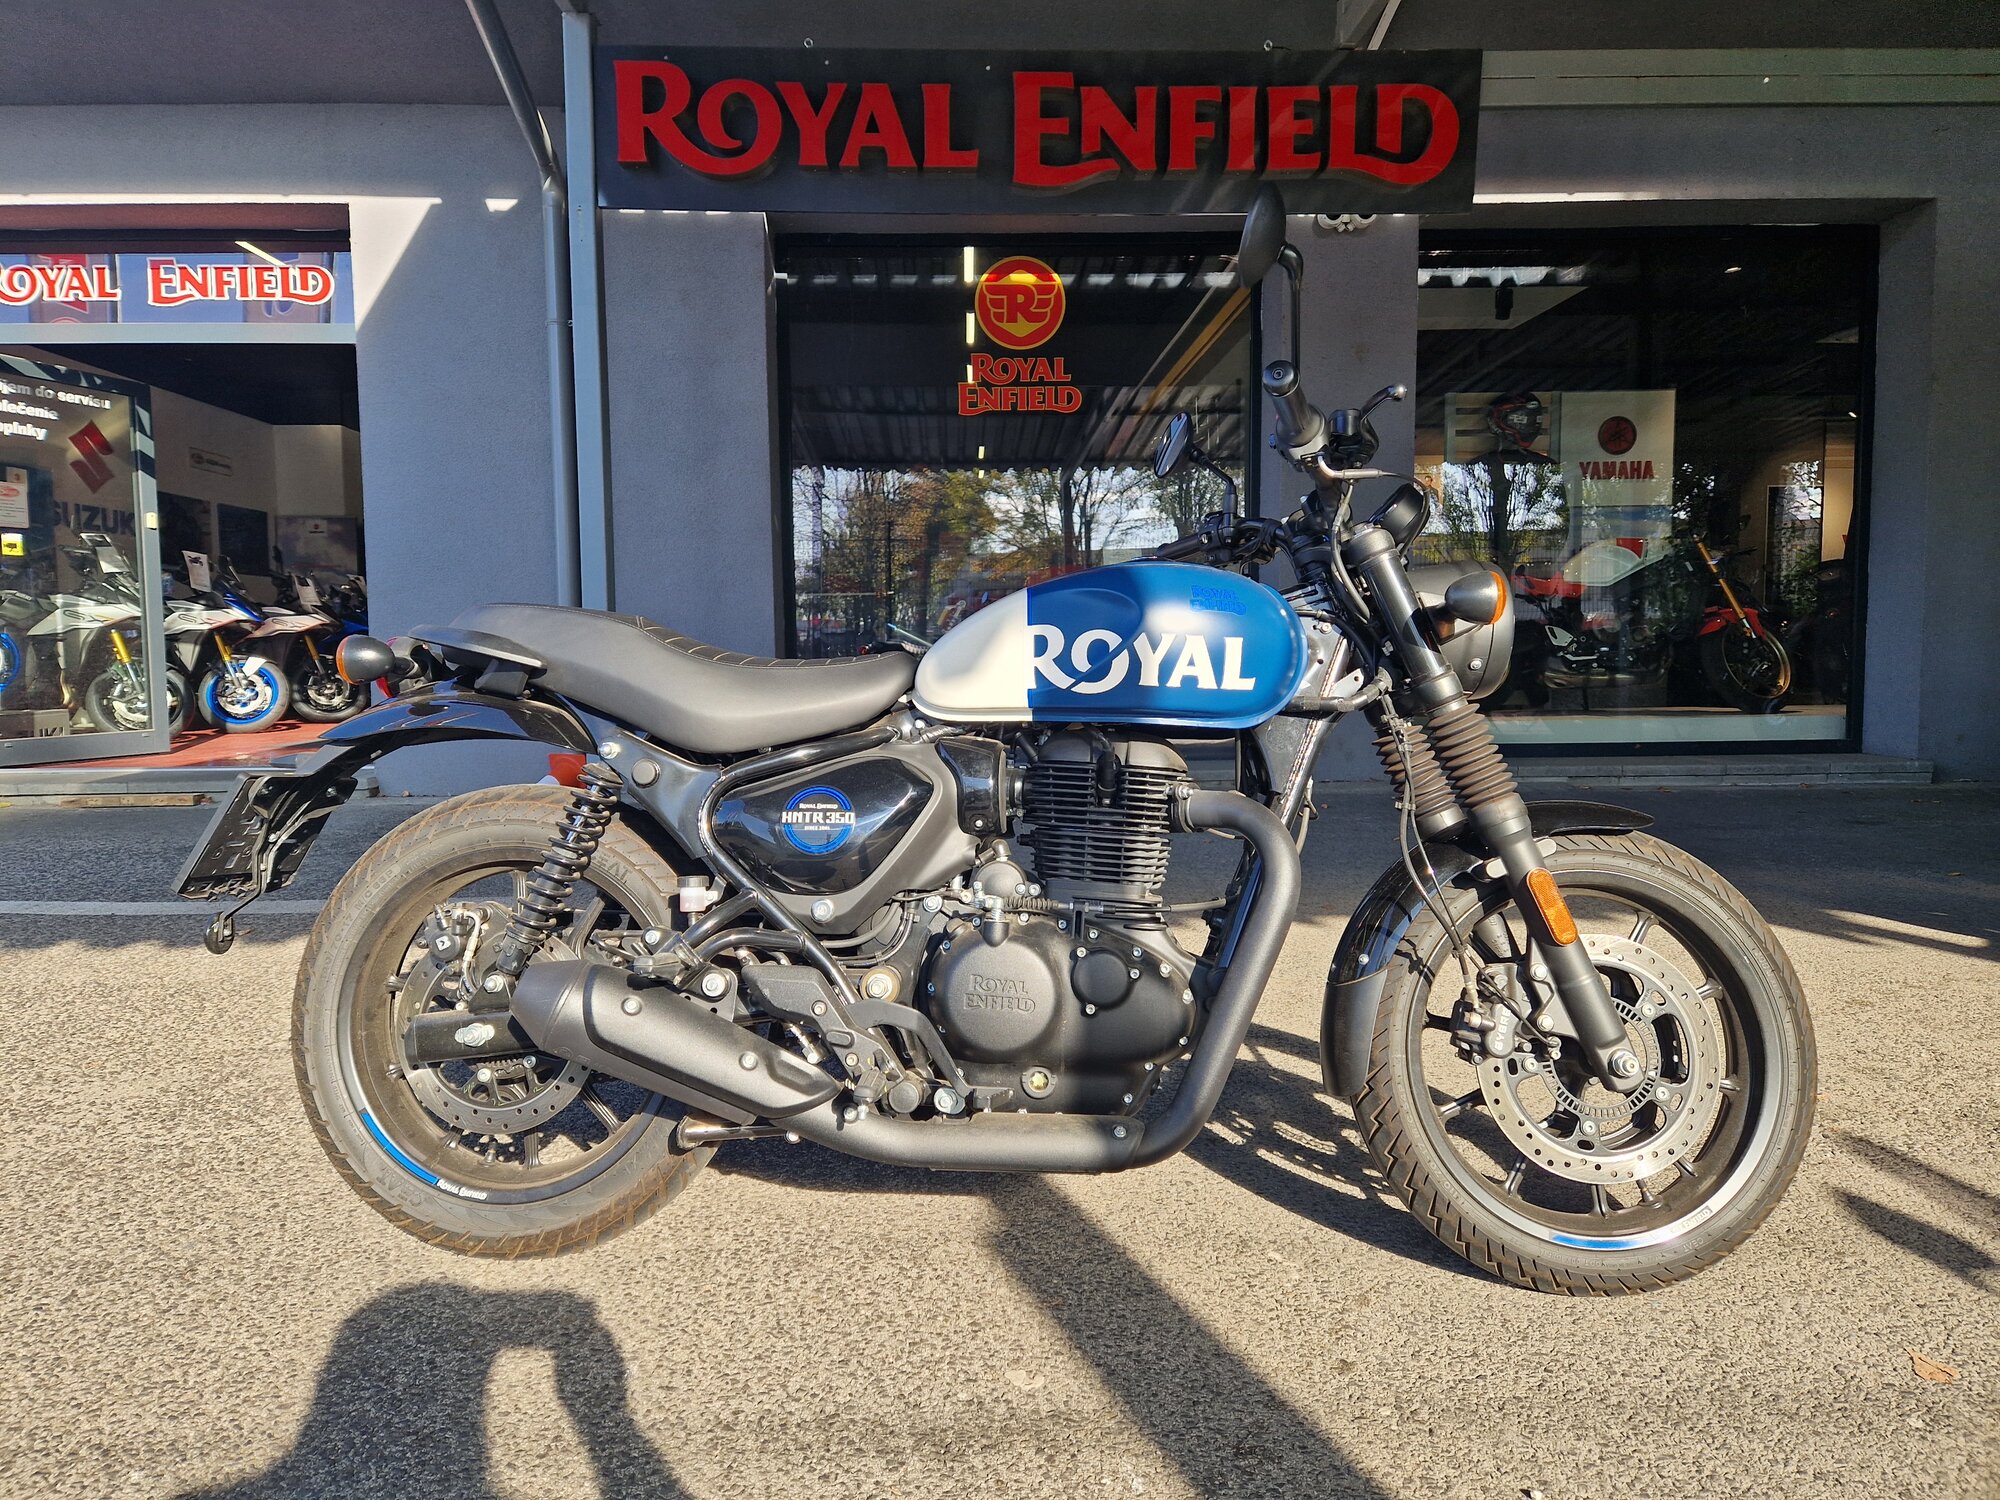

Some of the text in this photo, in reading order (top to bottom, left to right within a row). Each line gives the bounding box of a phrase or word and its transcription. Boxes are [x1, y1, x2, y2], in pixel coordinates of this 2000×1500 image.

[613, 59, 1460, 189] ROYAL ENFIELD
[0, 256, 335, 307] OYAL ENFIELD
[970, 353, 1072, 385] ROYAL
[35, 385, 56, 399] do
[57, 391, 112, 410] servisu
[957, 382, 1083, 416] ENFIELD
[1579, 460, 1655, 480] YAMAHA
[1190, 585, 1239, 601] ROYAL
[1026, 623, 1257, 694] ROYAL
[781, 811, 856, 824] HNTR 350
[970, 974, 1028, 995] ROYAL
[963, 992, 1037, 1014] ENFIELD
[376, 1168, 422, 1207] CEAT
[1680, 1235, 1705, 1253] CEAT
